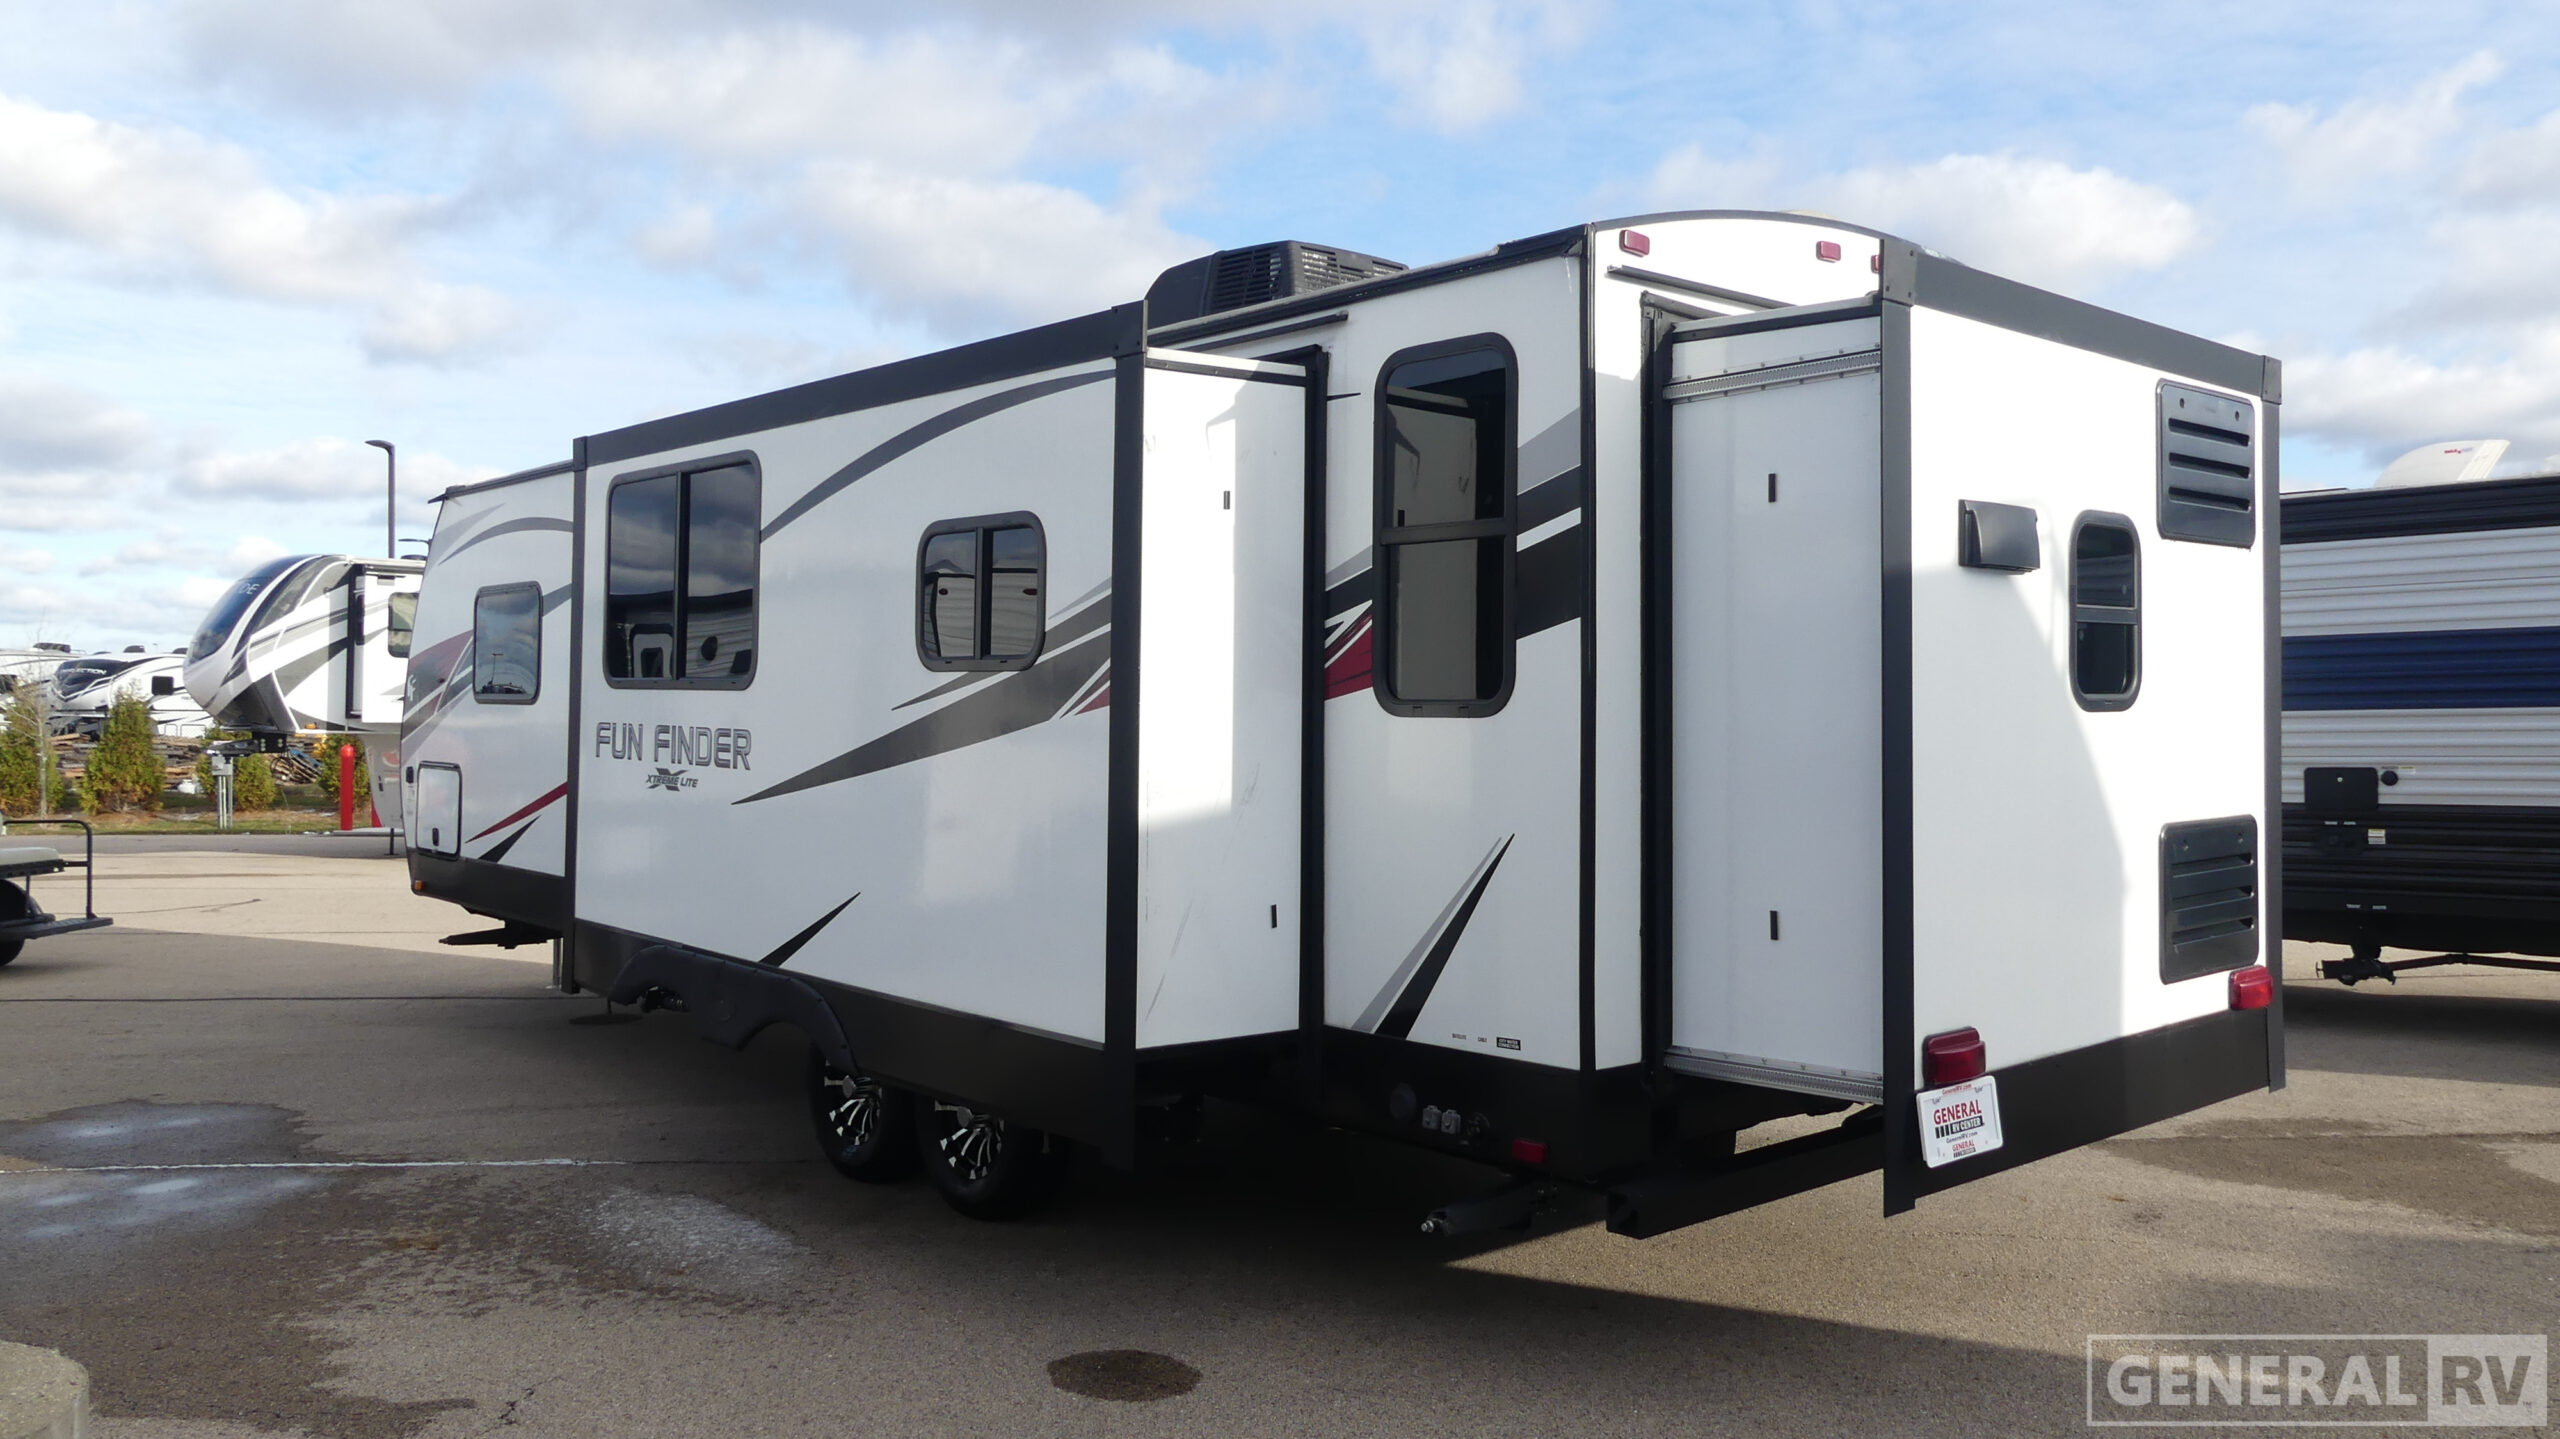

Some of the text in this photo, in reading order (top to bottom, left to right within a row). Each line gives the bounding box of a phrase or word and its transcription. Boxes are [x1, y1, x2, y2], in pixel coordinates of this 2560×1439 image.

[595, 721, 752, 771] FUN FINDER
[645, 774, 698, 788] XTREME LITE
[1934, 1099, 1982, 1125] GENERAL
[1961, 1117, 1981, 1131] CENTER
[1952, 1139, 1975, 1151] GENERAL
